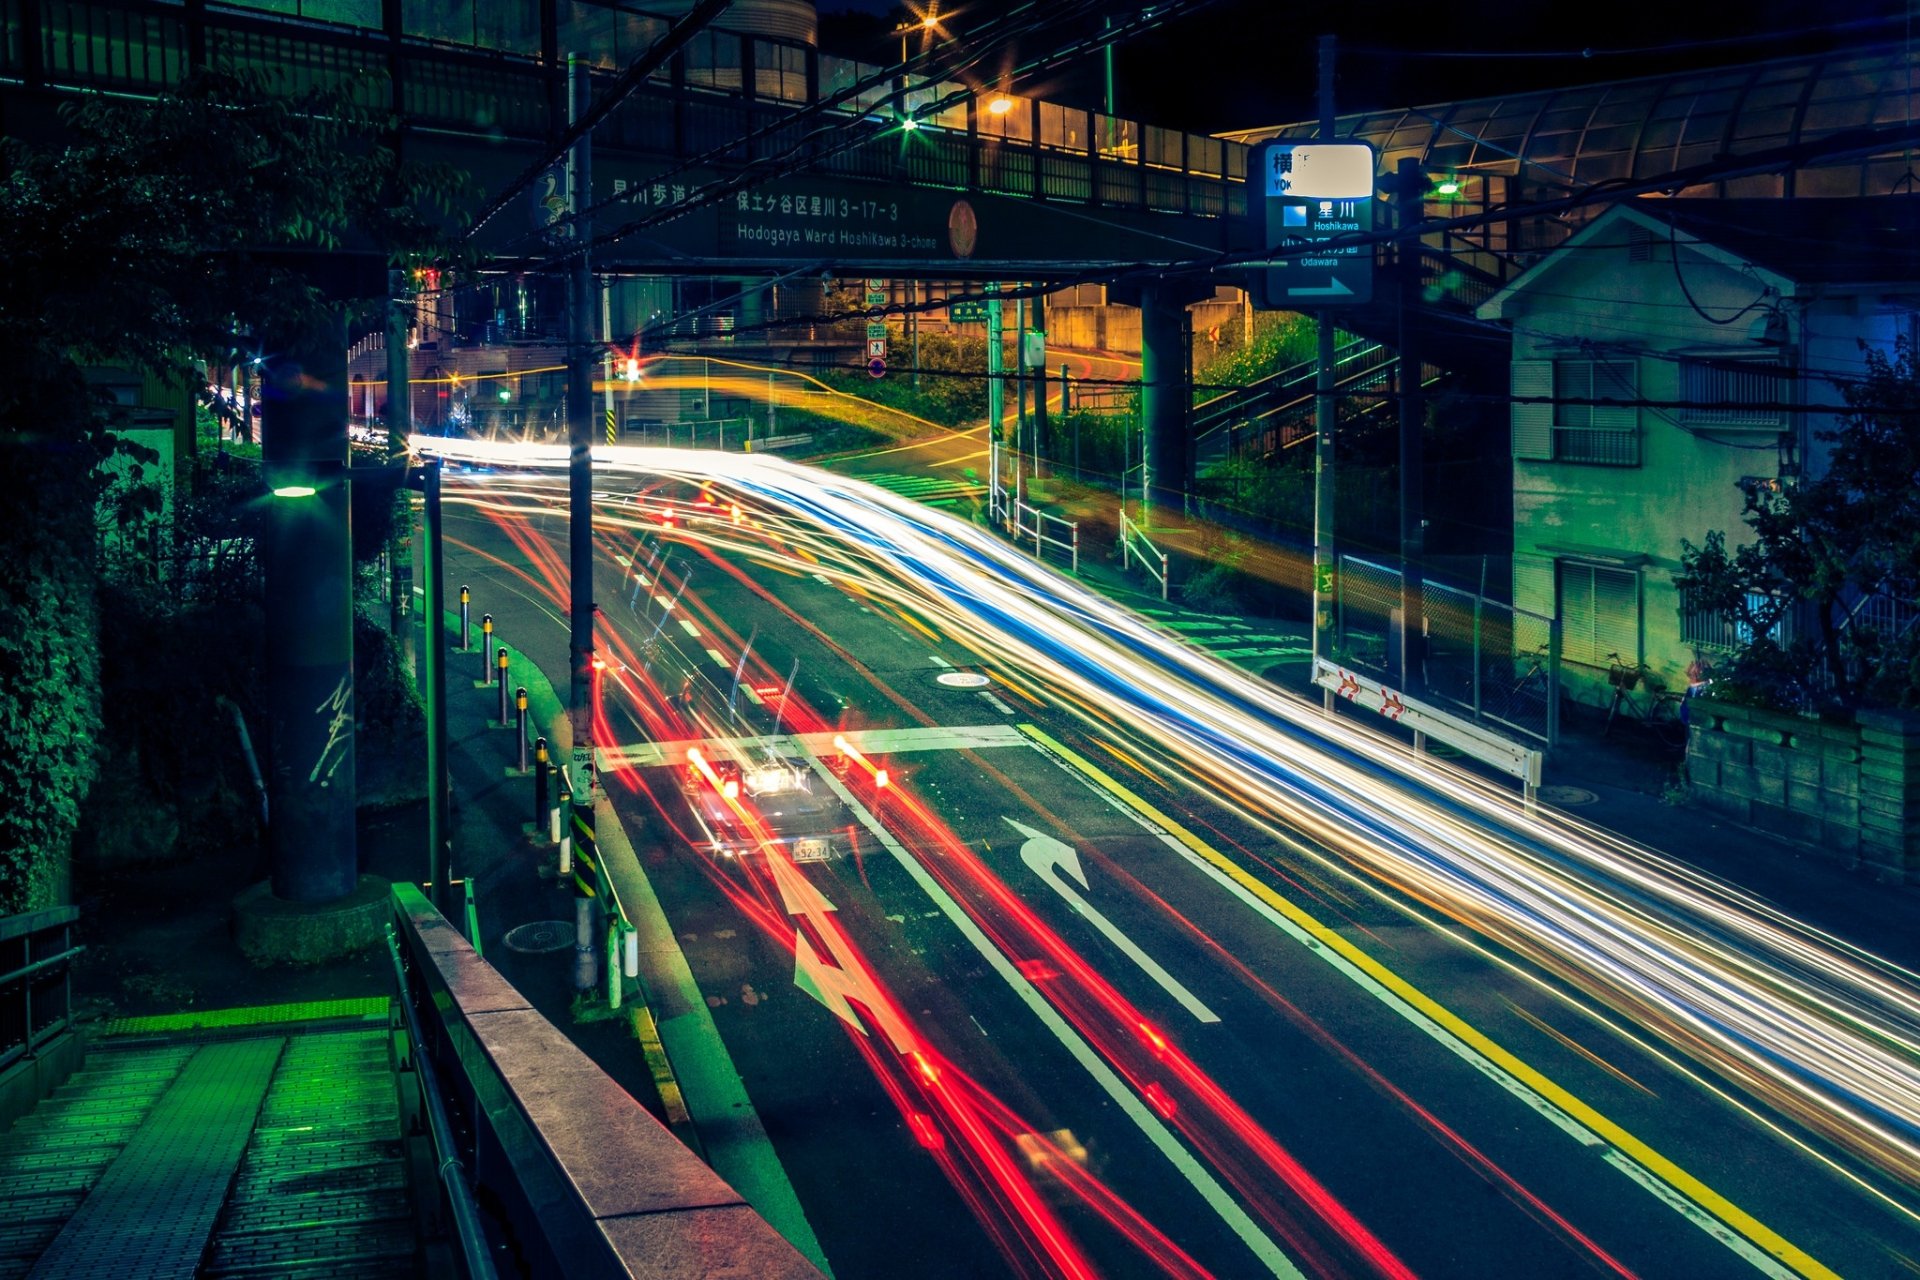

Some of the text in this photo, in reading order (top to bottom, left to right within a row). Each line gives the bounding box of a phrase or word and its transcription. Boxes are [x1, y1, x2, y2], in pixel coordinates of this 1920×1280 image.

[1318, 201, 1355, 219] 星川
[1314, 221, 1360, 231] Hoshikawa
[737, 223, 800, 247] Hodogaya
[804, 227, 835, 245] Ward
[1300, 257, 1338, 267] Odawara
